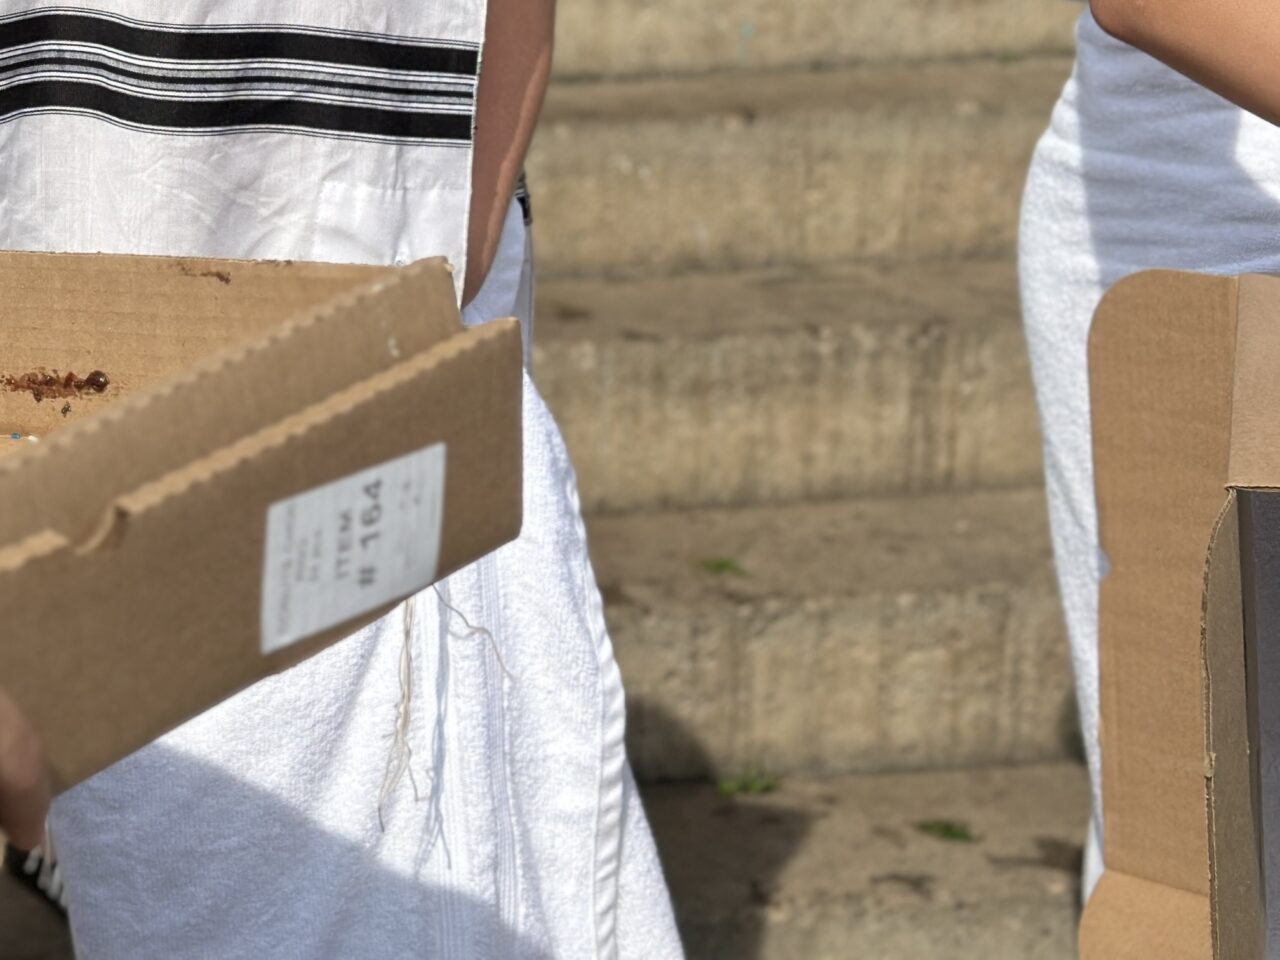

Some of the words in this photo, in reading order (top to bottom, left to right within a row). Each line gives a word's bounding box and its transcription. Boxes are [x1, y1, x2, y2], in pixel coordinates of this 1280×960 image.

[336, 510, 352, 580] ITEM
[360, 478, 382, 550] 164
[358, 565, 376, 587] #
